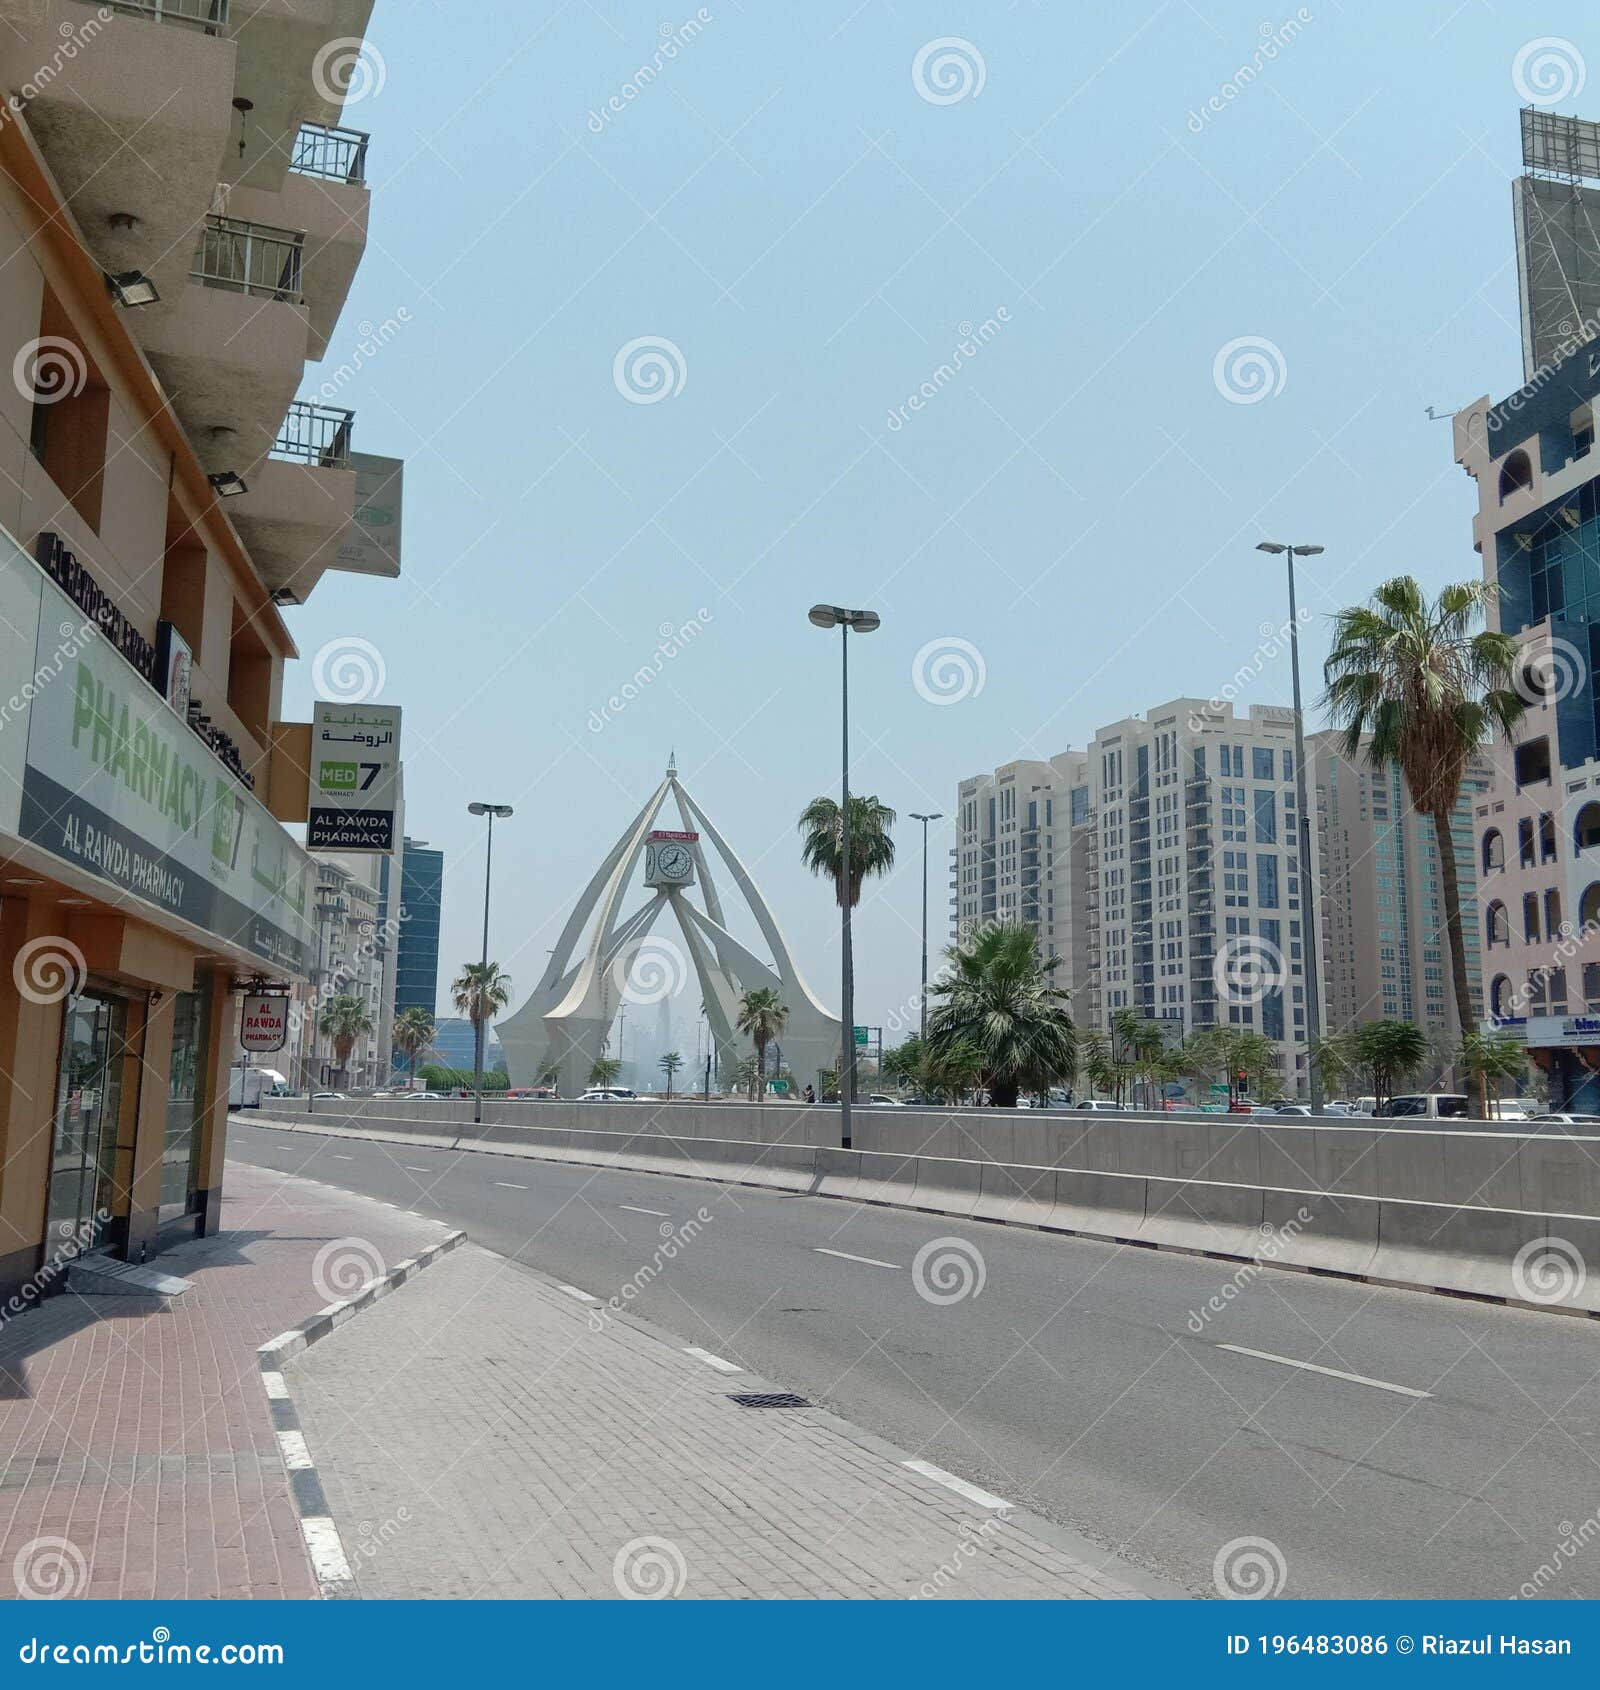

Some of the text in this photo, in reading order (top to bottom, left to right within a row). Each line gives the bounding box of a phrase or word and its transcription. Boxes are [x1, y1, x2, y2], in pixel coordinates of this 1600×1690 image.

[323, 711, 393, 729] صيدلية
[322, 729, 393, 748] الروضة
[71, 661, 207, 840] PHARMACY
[321, 762, 382, 791] MED 7
[315, 815, 389, 829] AL RAWDA
[313, 830, 389, 844] PHARMACY
[62, 813, 80, 855] AL
[84, 824, 130, 881] RAWDA
[132, 853, 185, 908] PHARMACY
[260, 1003, 271, 1014] AL
[246, 1017, 282, 1029] RAWDA
[245, 1033, 282, 1041] PHARMACY
